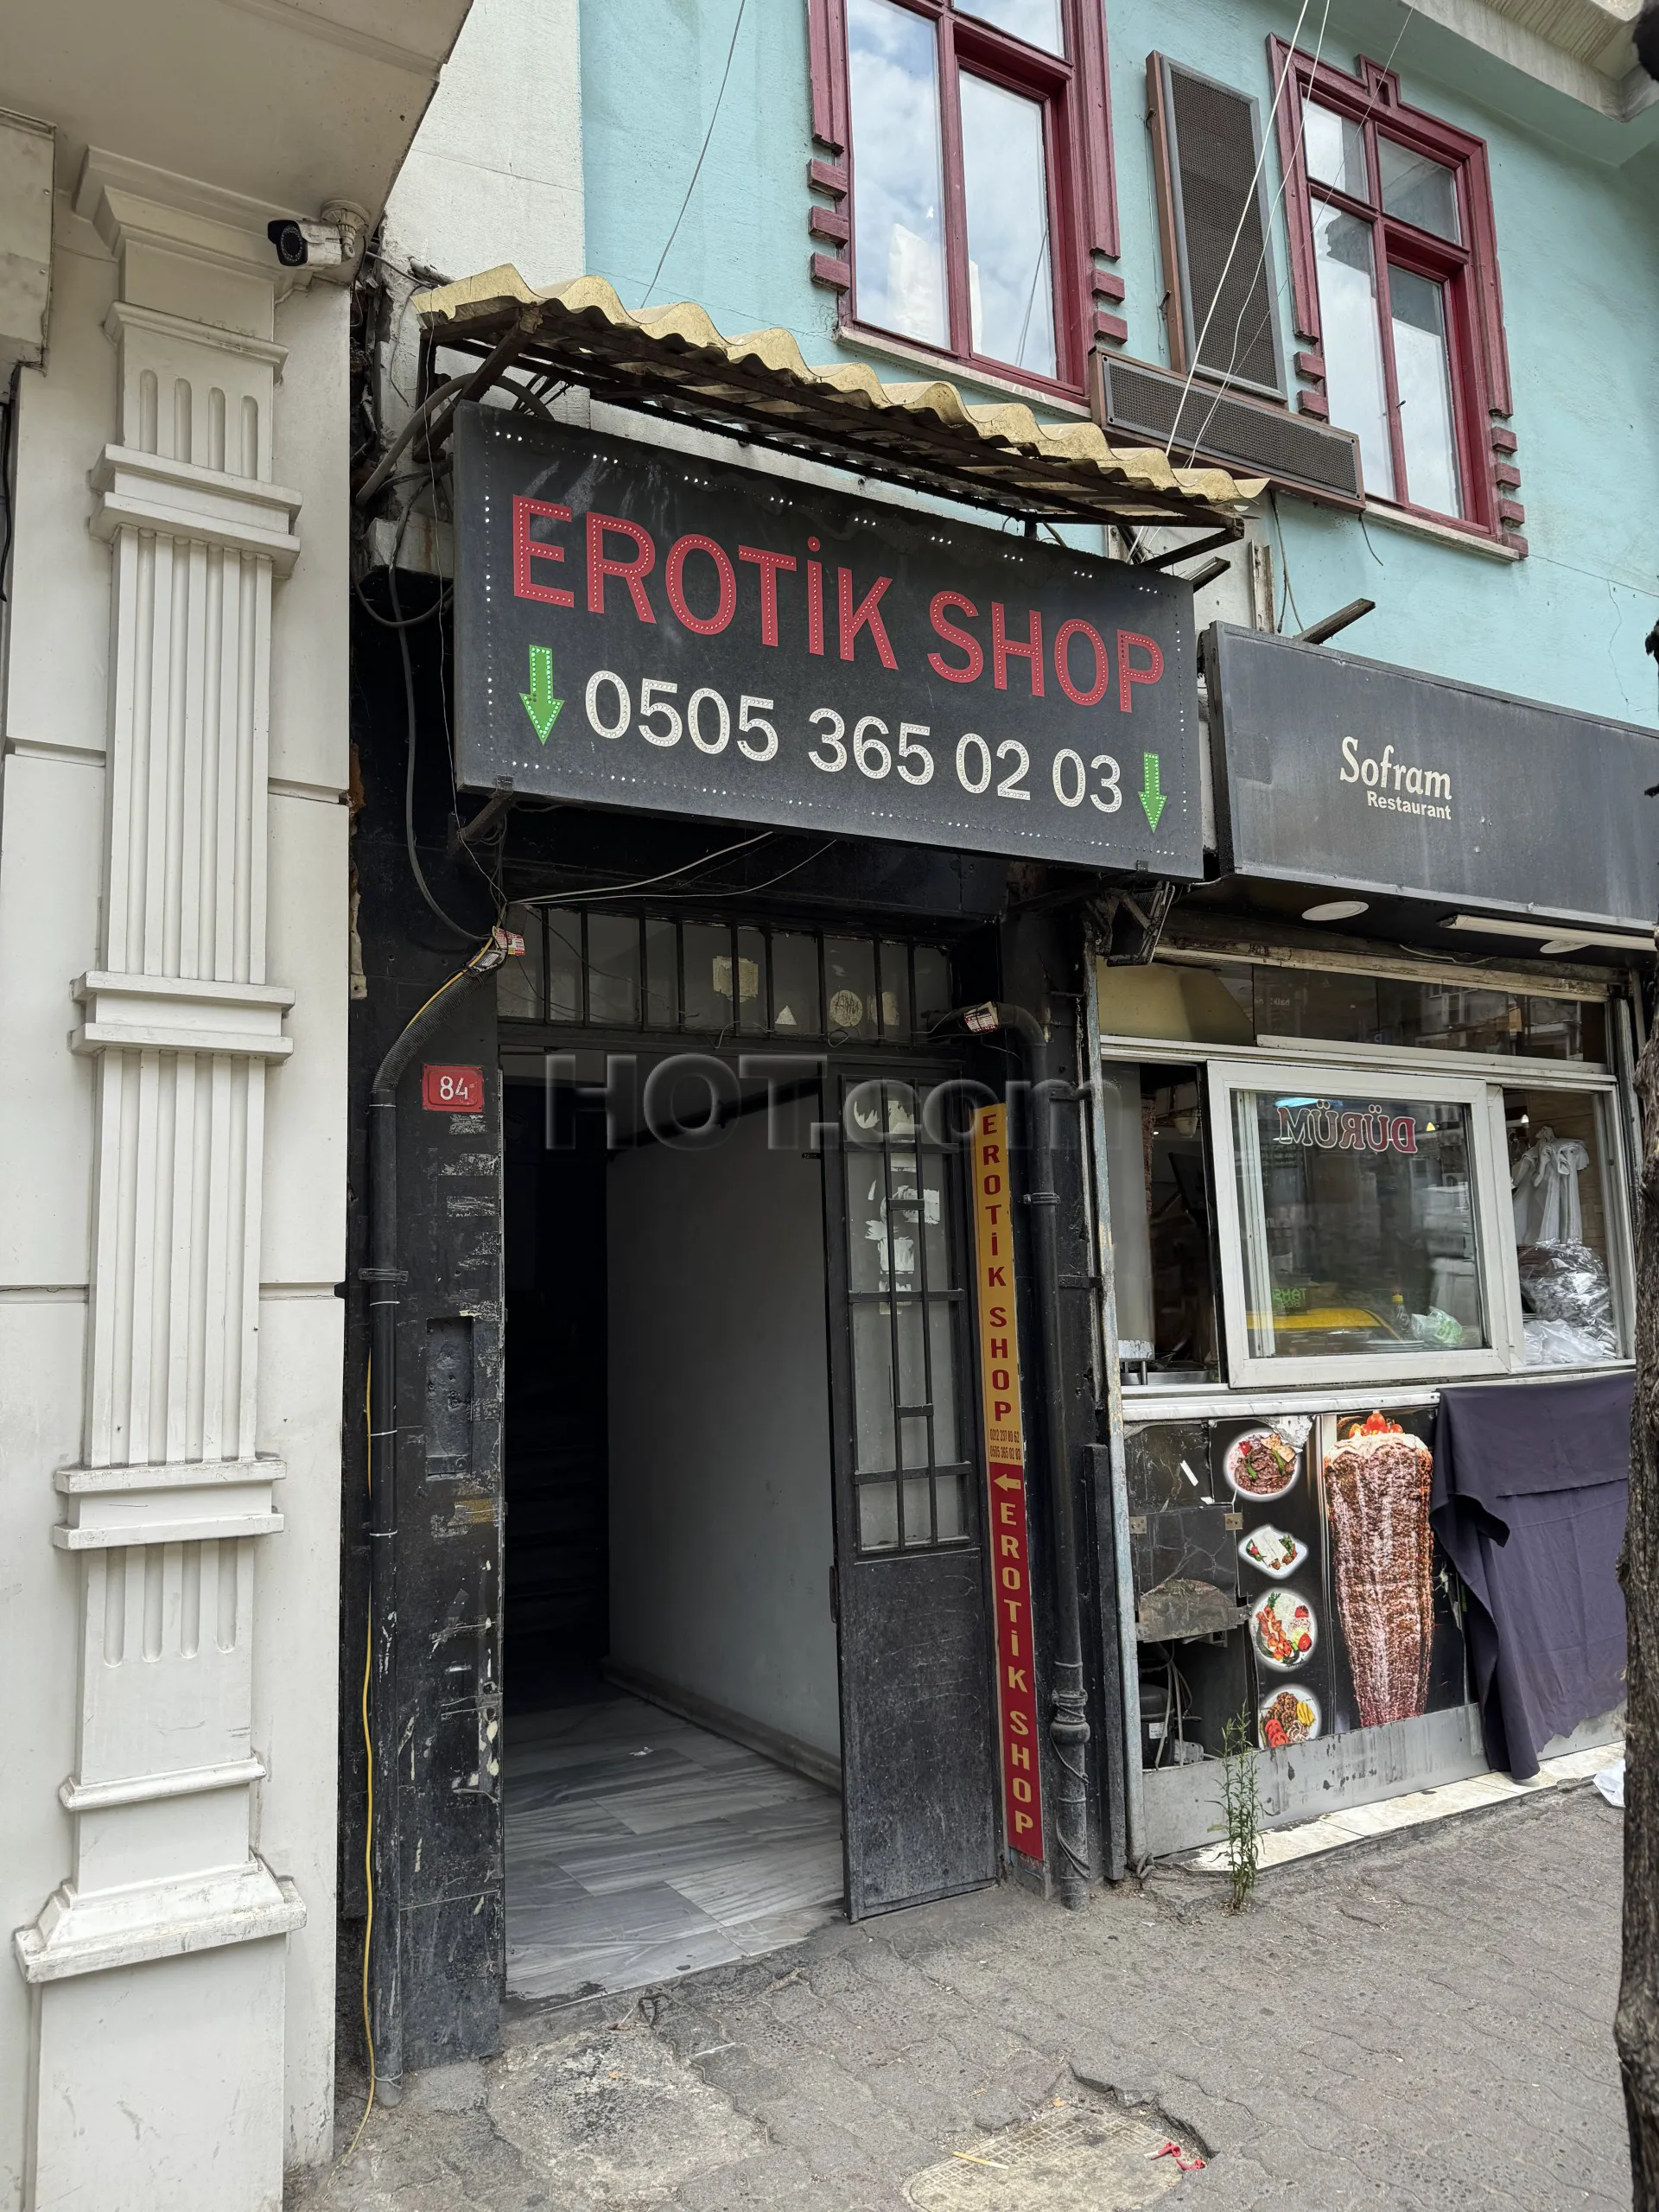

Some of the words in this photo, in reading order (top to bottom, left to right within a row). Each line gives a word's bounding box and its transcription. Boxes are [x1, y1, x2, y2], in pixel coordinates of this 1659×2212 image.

[513, 494, 899, 671] EROTİK
[927, 590, 1165, 714] SHOP
[585, 671, 779, 762] 0505
[808, 708, 934, 786] 365
[956, 733, 1032, 802] 02
[1052, 748, 1123, 814] 03
[1339, 736, 1452, 801] Sofram
[1367, 791, 1452, 821] Restaurant
[440, 1076, 468, 1101] 84
[982, 1114, 1007, 1287] EROTİK
[988, 1306, 1012, 1422] SHOP
[1000, 1502, 1028, 1692] EROTİK
[1009, 1710, 1033, 1834] SHOP
